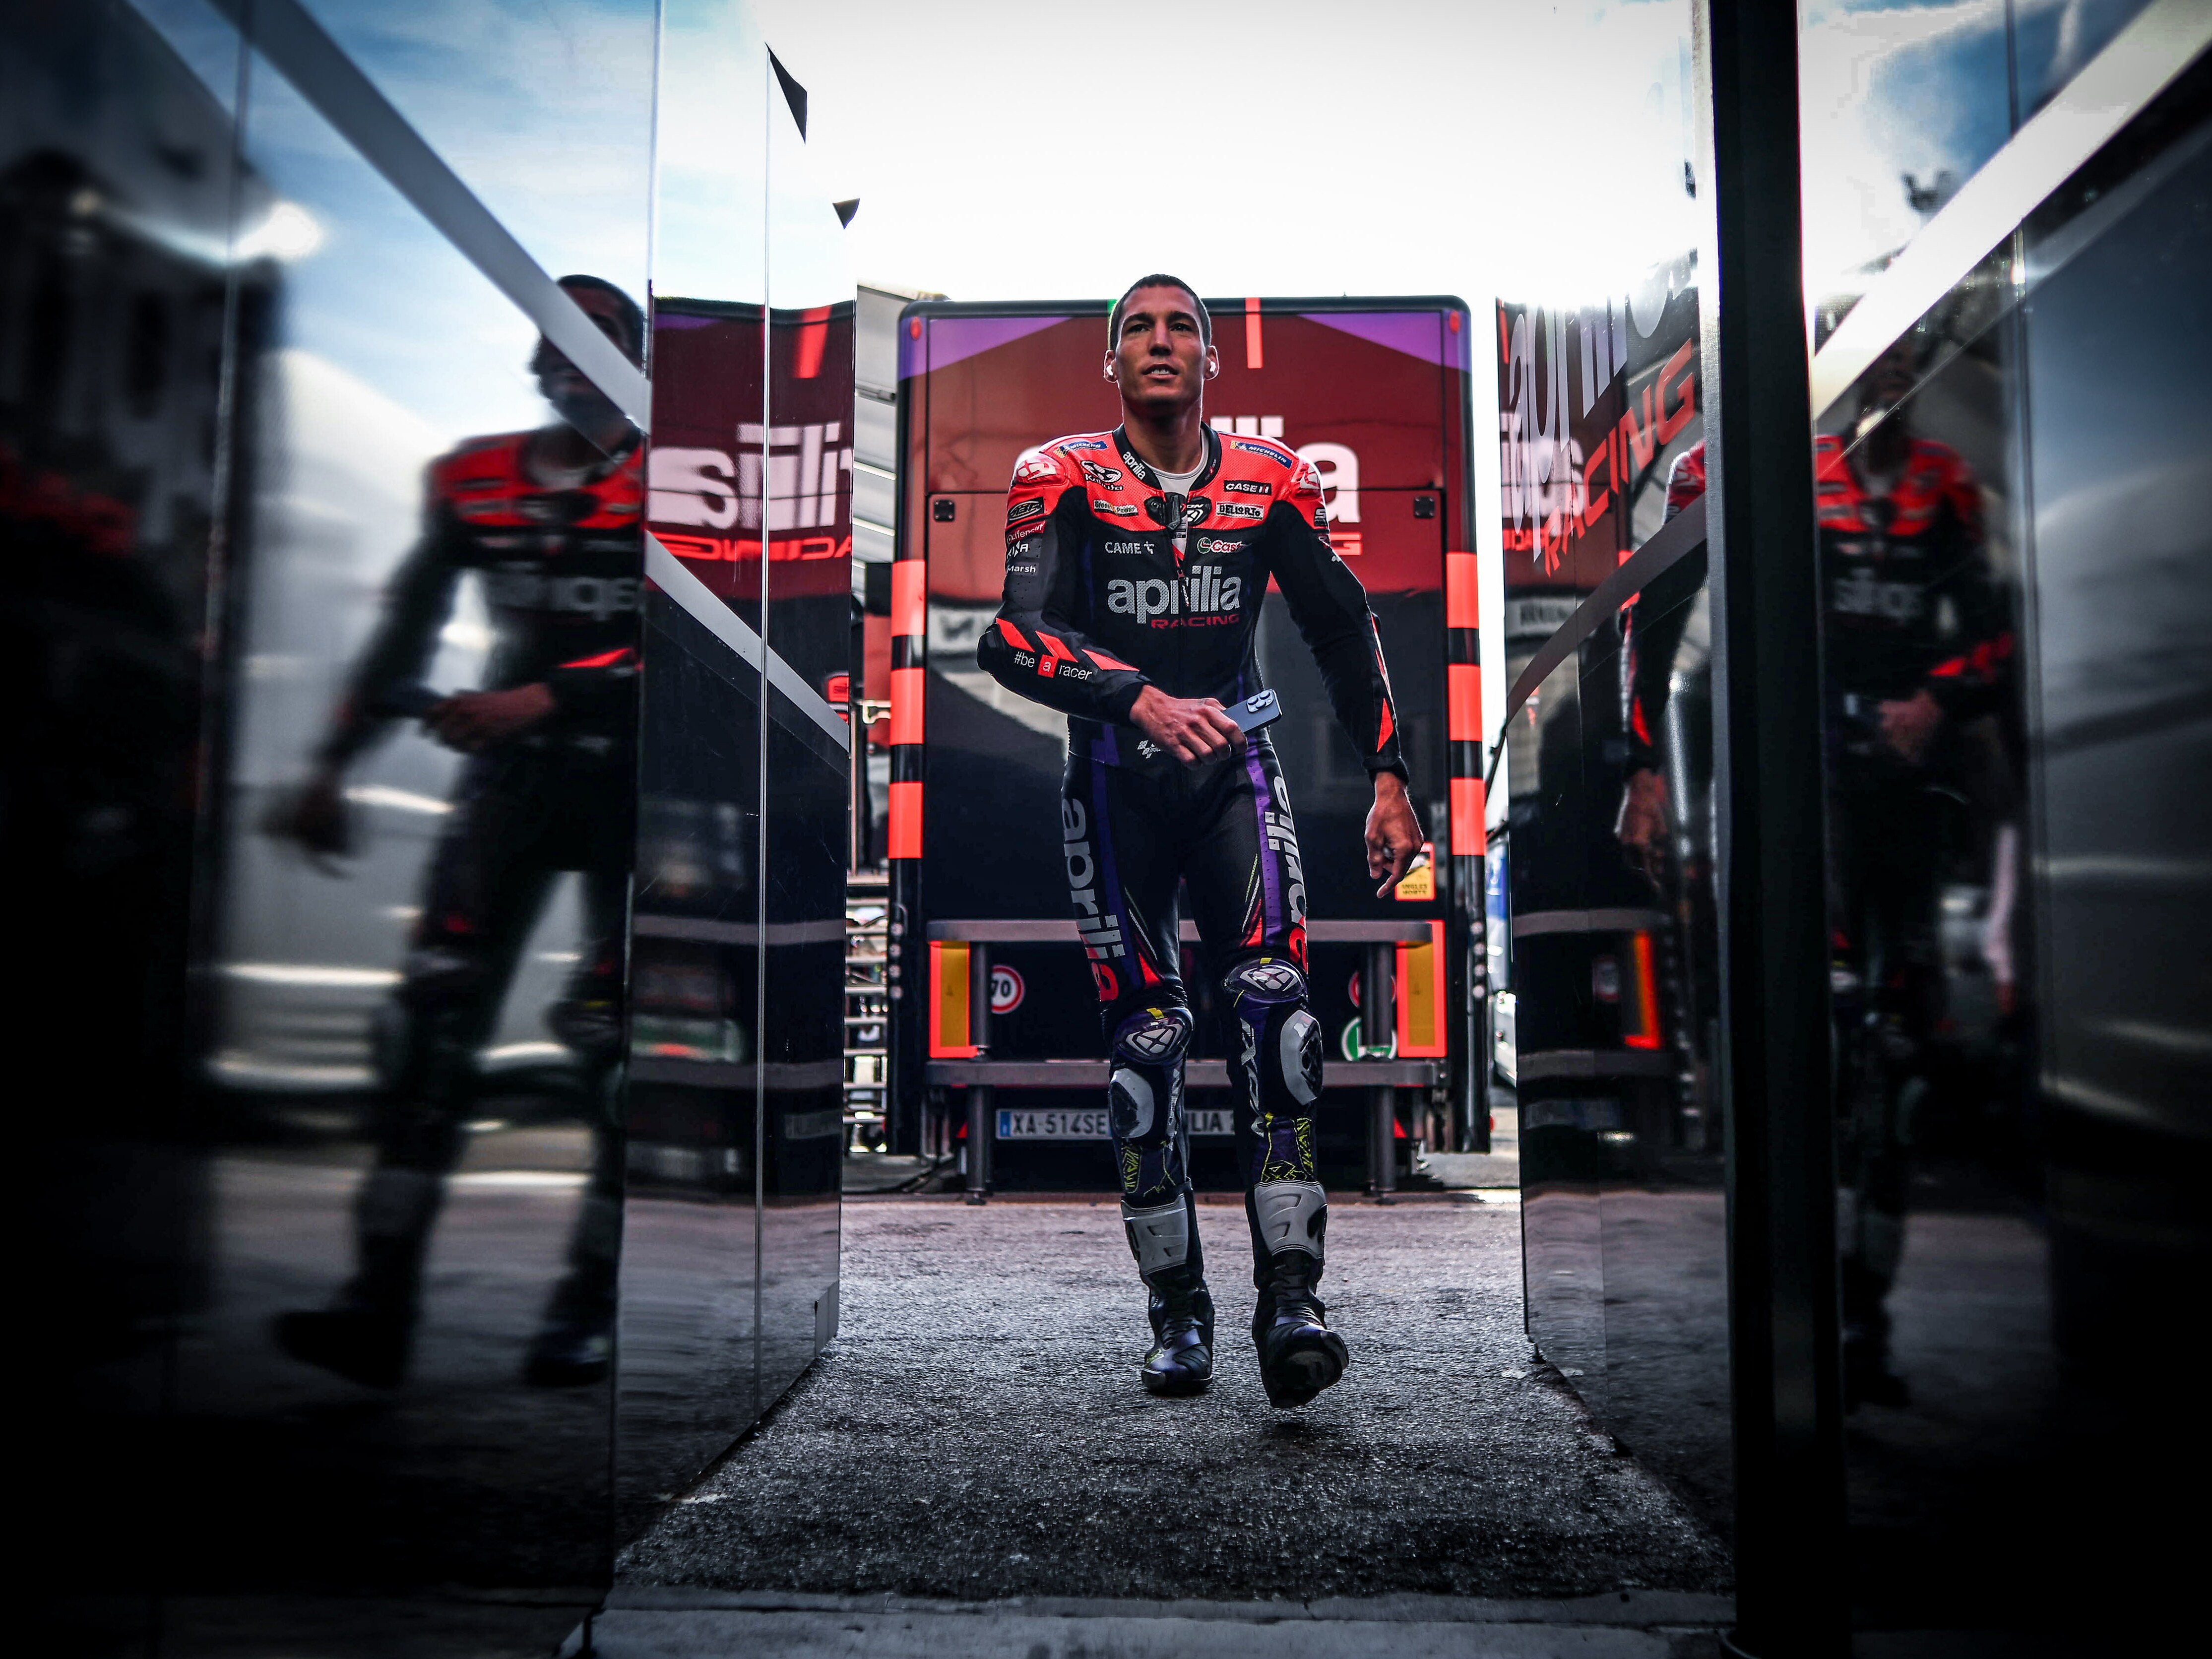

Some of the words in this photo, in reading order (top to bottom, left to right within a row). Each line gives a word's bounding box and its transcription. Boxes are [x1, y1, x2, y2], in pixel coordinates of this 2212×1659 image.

[1248, 446, 1287, 463] MICHELIN
[1544, 338, 1695, 577] RACING
[1123, 451, 1146, 480] aprilia
[1225, 483, 1258, 493] CASE
[1105, 542, 1142, 555] CAME
[1007, 565, 1036, 575] Marsh
[1107, 566, 1242, 624] aprilia
[1151, 613, 1240, 629] RACING
[1014, 651, 1035, 668] #be
[1043, 661, 1051, 672] a
[1059, 664, 1092, 680] racer
[1062, 798, 1126, 1002] aprilia
[991, 979, 1011, 998] 70
